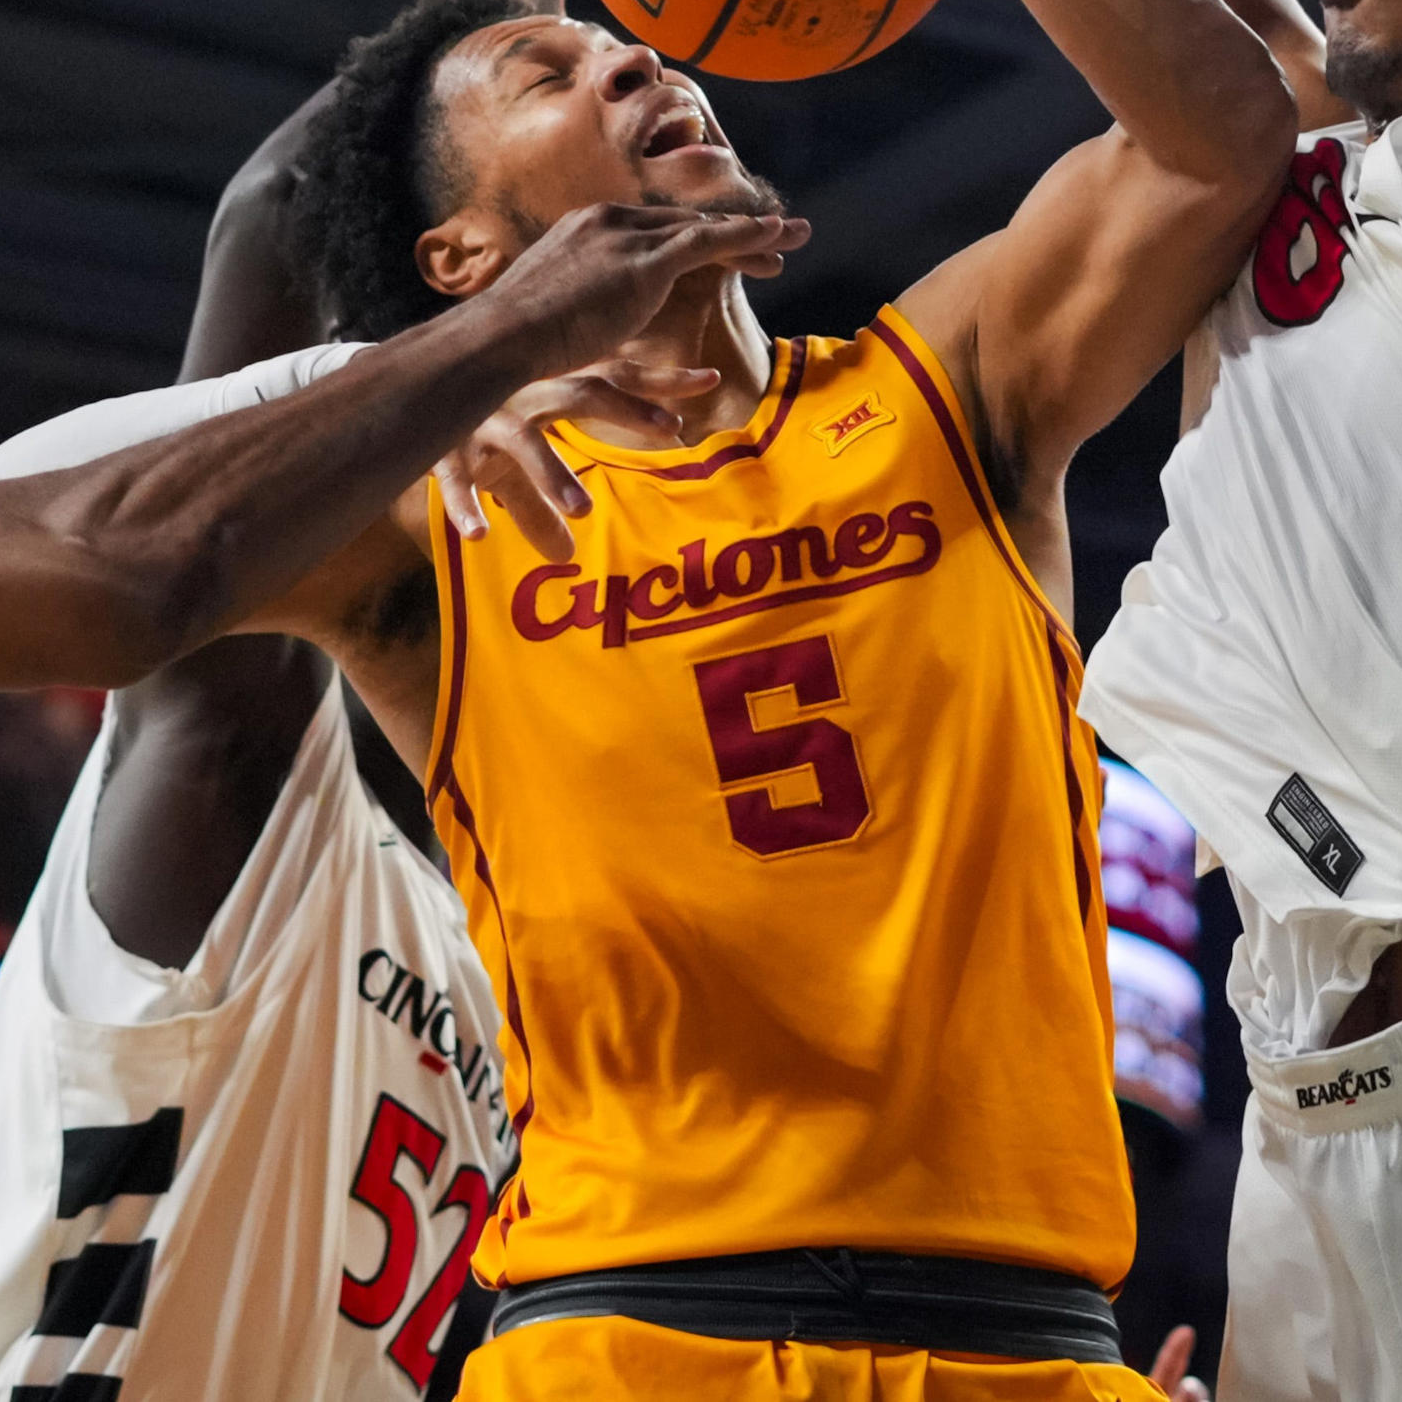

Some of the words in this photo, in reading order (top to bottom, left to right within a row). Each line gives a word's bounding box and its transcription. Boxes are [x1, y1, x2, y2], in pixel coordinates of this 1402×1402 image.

[511, 500, 943, 649] Cyclones
[688, 632, 876, 861] 5
[1321, 842, 1343, 876] XL
[1296, 1066, 1392, 1109] BEARCATS
[339, 1091, 491, 1396] 52
